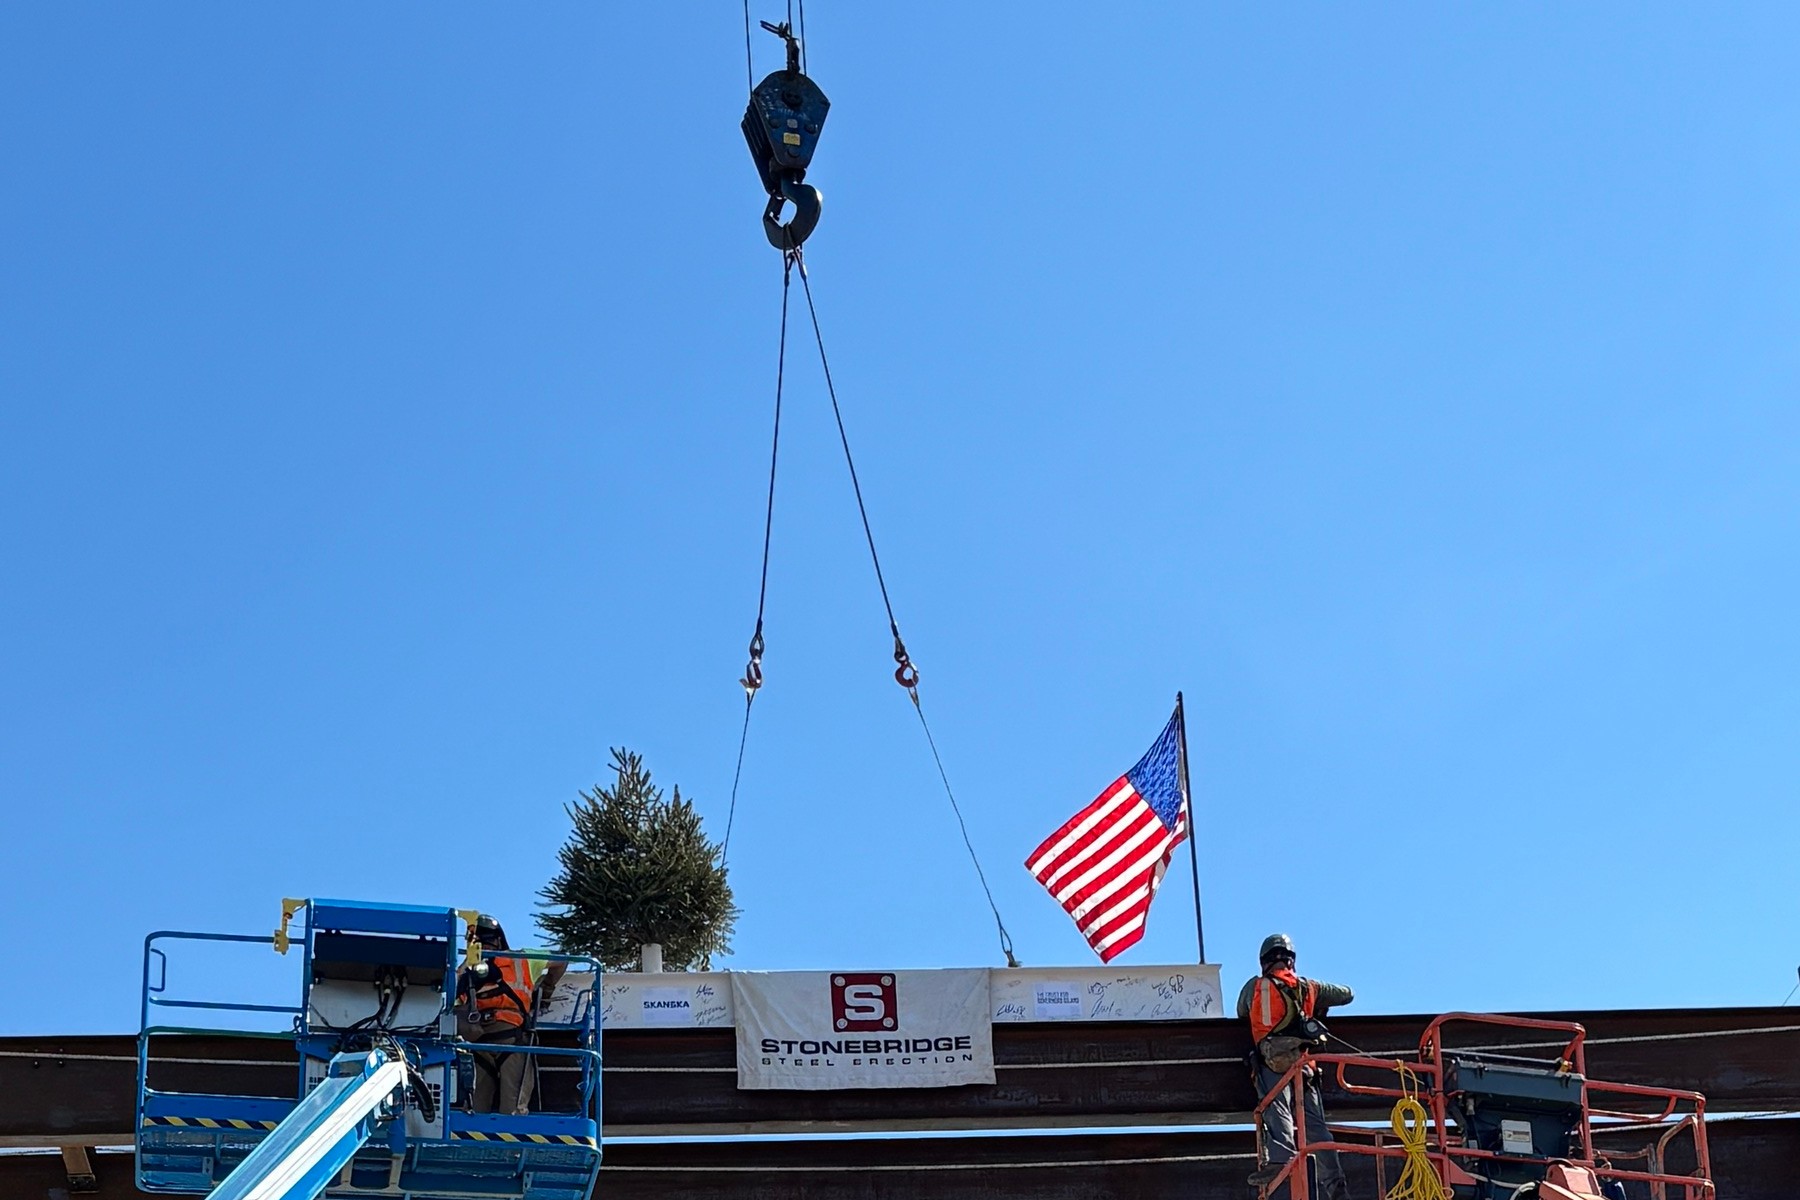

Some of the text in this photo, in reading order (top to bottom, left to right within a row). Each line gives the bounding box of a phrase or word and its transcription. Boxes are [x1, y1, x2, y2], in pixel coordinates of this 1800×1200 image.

[643, 1000, 690, 1009] SKANSKA
[844, 984, 885, 1021] S
[761, 1036, 972, 1055] STONEBRIDGE
[761, 1054, 973, 1067] STEEL ERECTION
